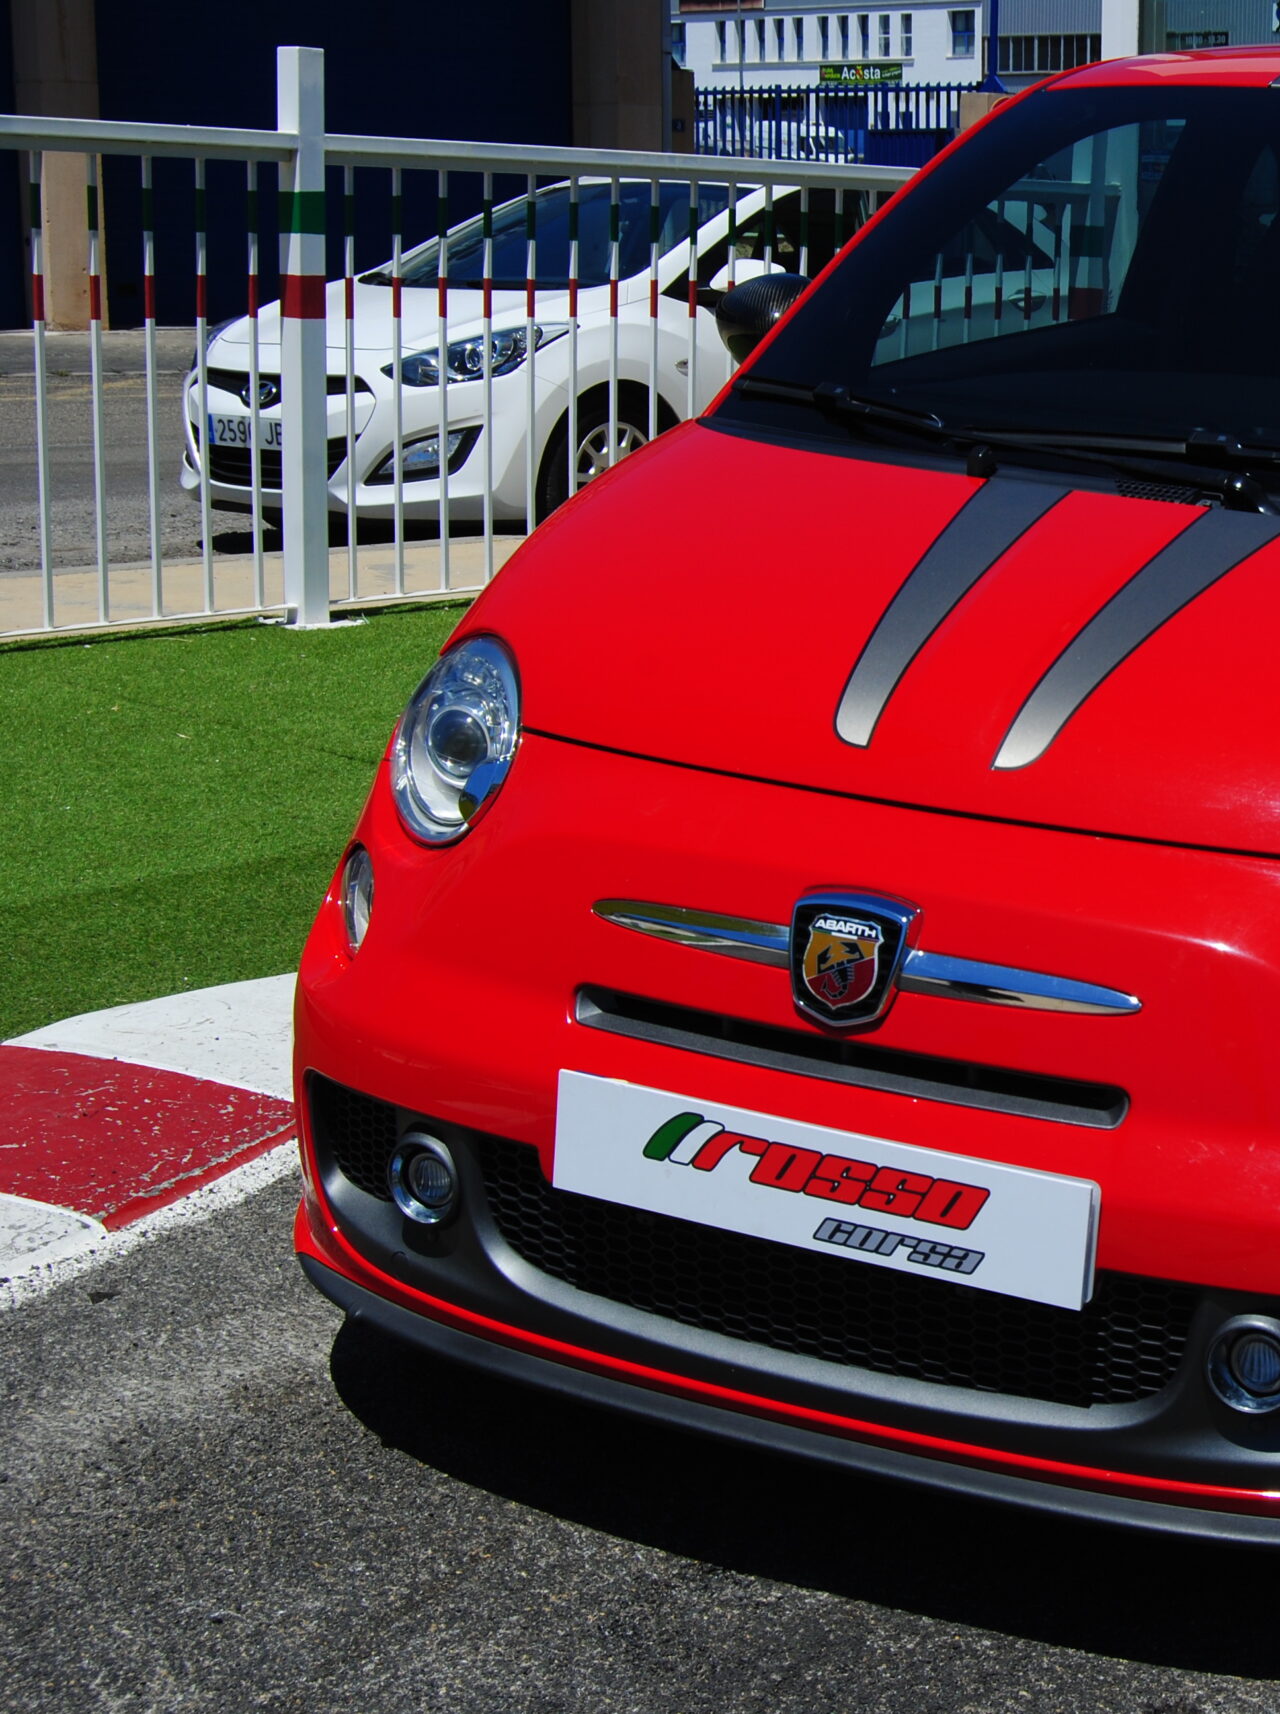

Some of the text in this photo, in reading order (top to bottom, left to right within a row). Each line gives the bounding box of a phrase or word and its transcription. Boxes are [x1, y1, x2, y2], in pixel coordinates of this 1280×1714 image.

[841, 65, 881, 80] Acosta
[217, 418, 252, 443] 259
[815, 918, 877, 938] ABARTH
[691, 1130, 991, 1230] rosso
[812, 1216, 986, 1275] corsa
